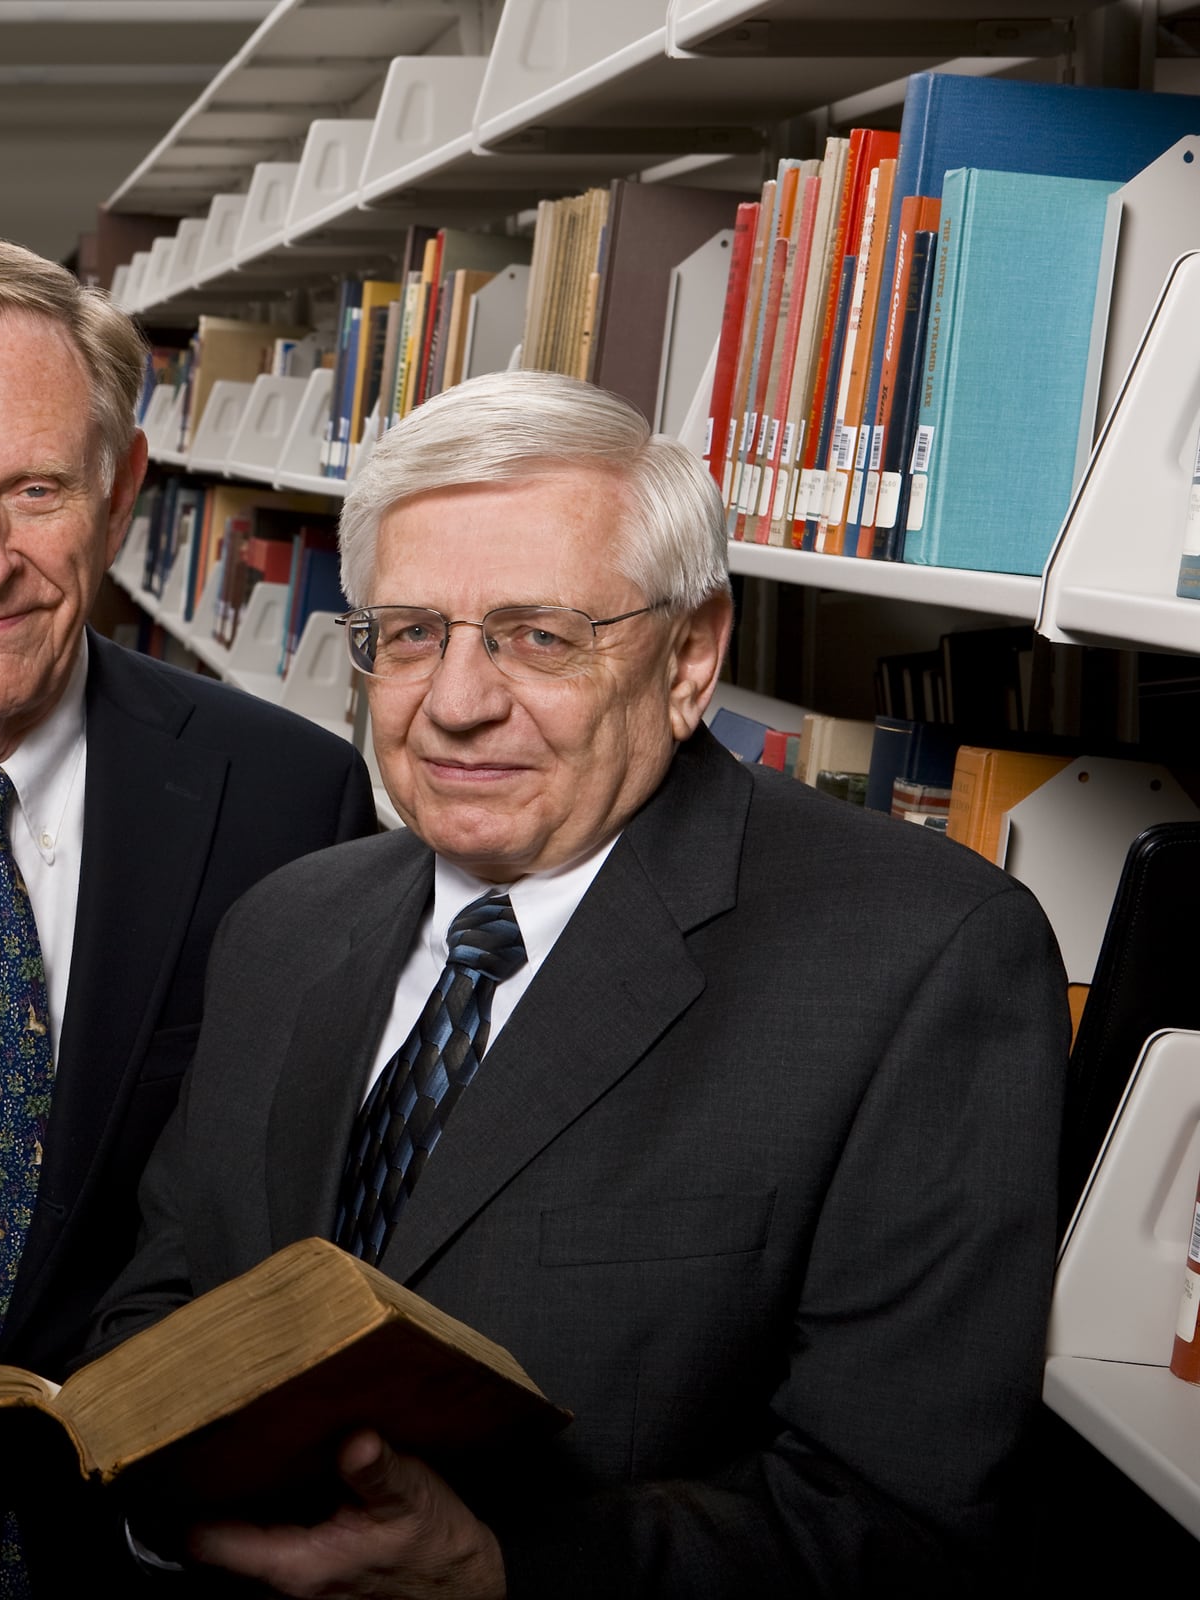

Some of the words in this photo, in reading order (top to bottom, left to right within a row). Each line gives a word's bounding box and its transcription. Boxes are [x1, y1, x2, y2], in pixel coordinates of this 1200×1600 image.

[942, 219, 952, 243] THE
[895, 230, 907, 290] Indian
[936, 247, 948, 297] PAIUTES
[885, 291, 901, 362] Oratory
[928, 317, 941, 372] PYRAMID
[924, 376, 934, 408] LAKE
